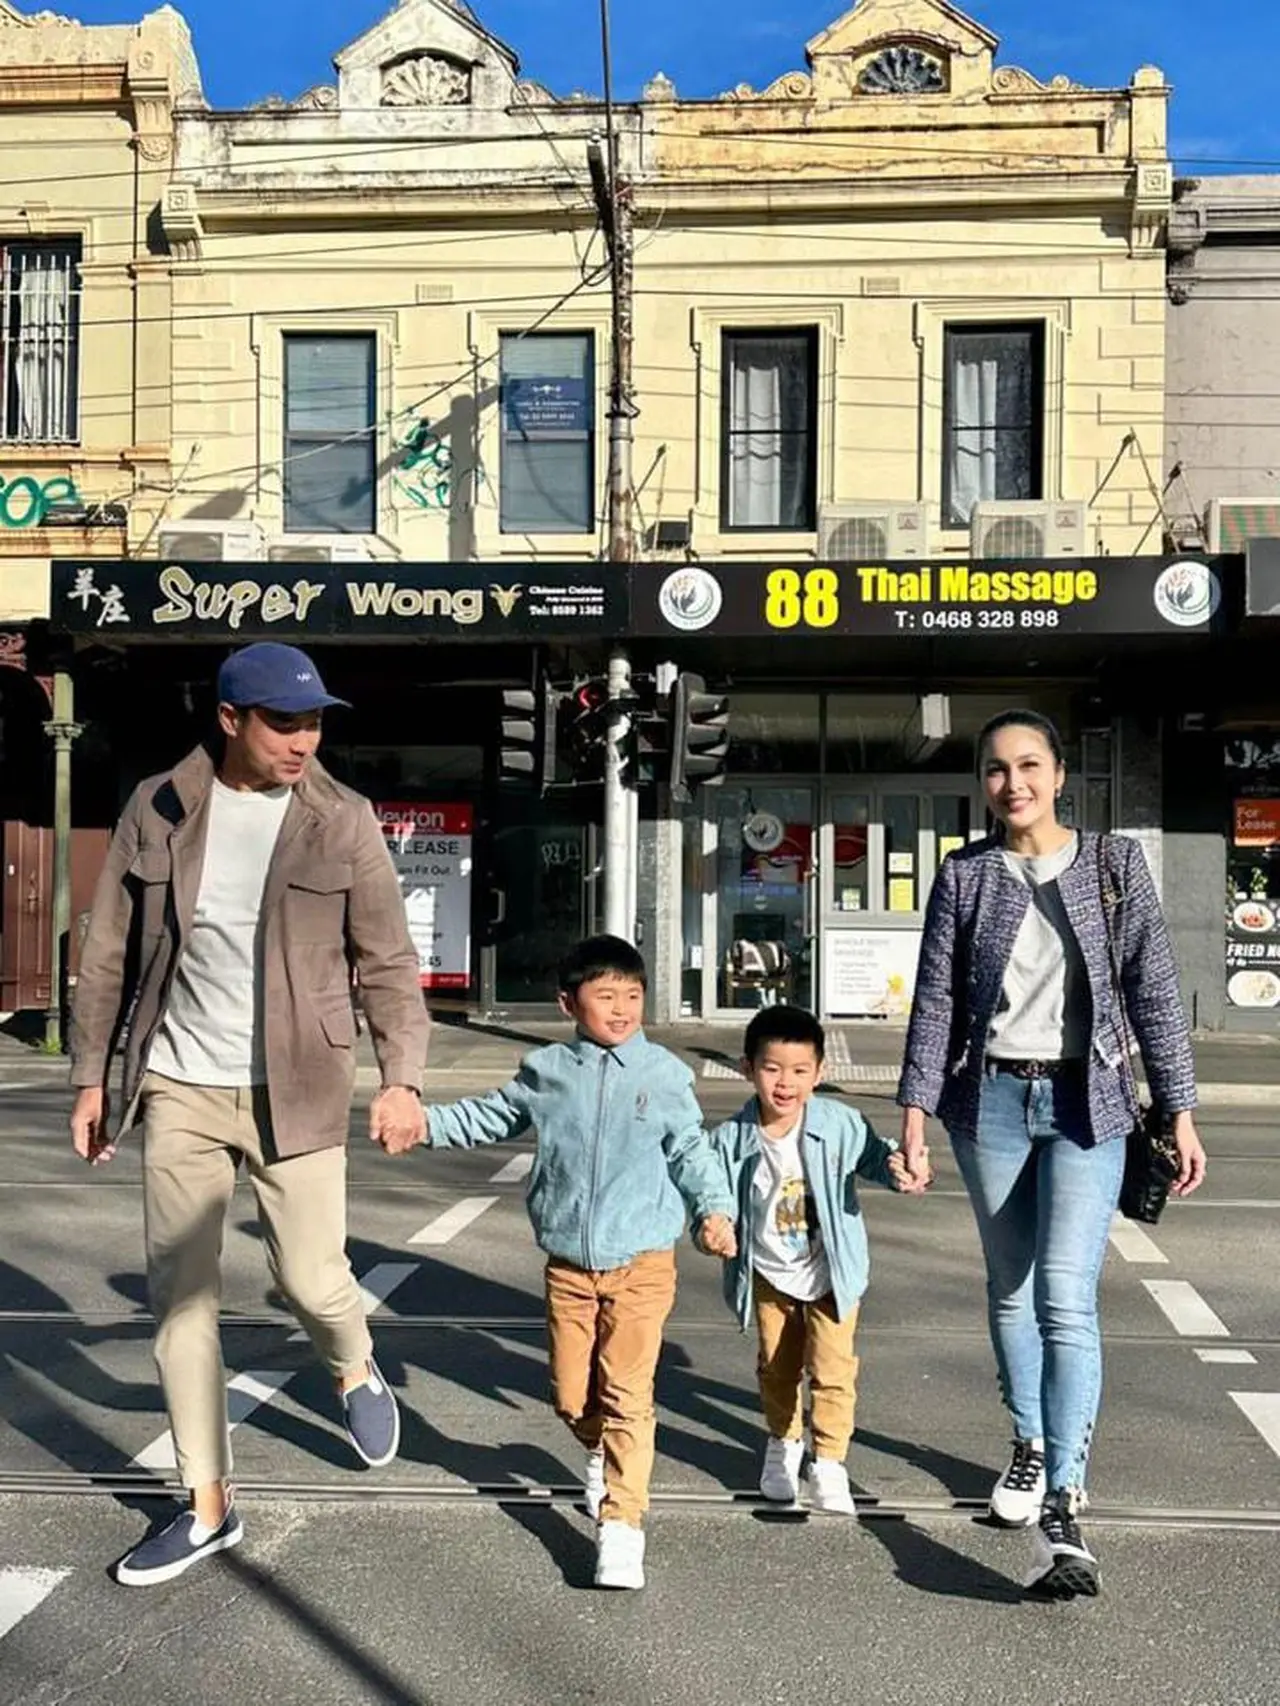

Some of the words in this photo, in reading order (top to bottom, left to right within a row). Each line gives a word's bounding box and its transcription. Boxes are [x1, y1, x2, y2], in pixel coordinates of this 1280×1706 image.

[153, 566, 326, 629] Super
[346, 582, 484, 624] Wong
[765, 568, 839, 629] 88
[857, 566, 932, 603] Thai
[939, 566, 1098, 606] Massage
[894, 610, 915, 629] T:
[921, 610, 973, 629] 0468
[977, 610, 1015, 629] 328
[1019, 609, 1059, 628] 898
[1237, 807, 1258, 819] For
[1227, 943, 1265, 957] FRIED
